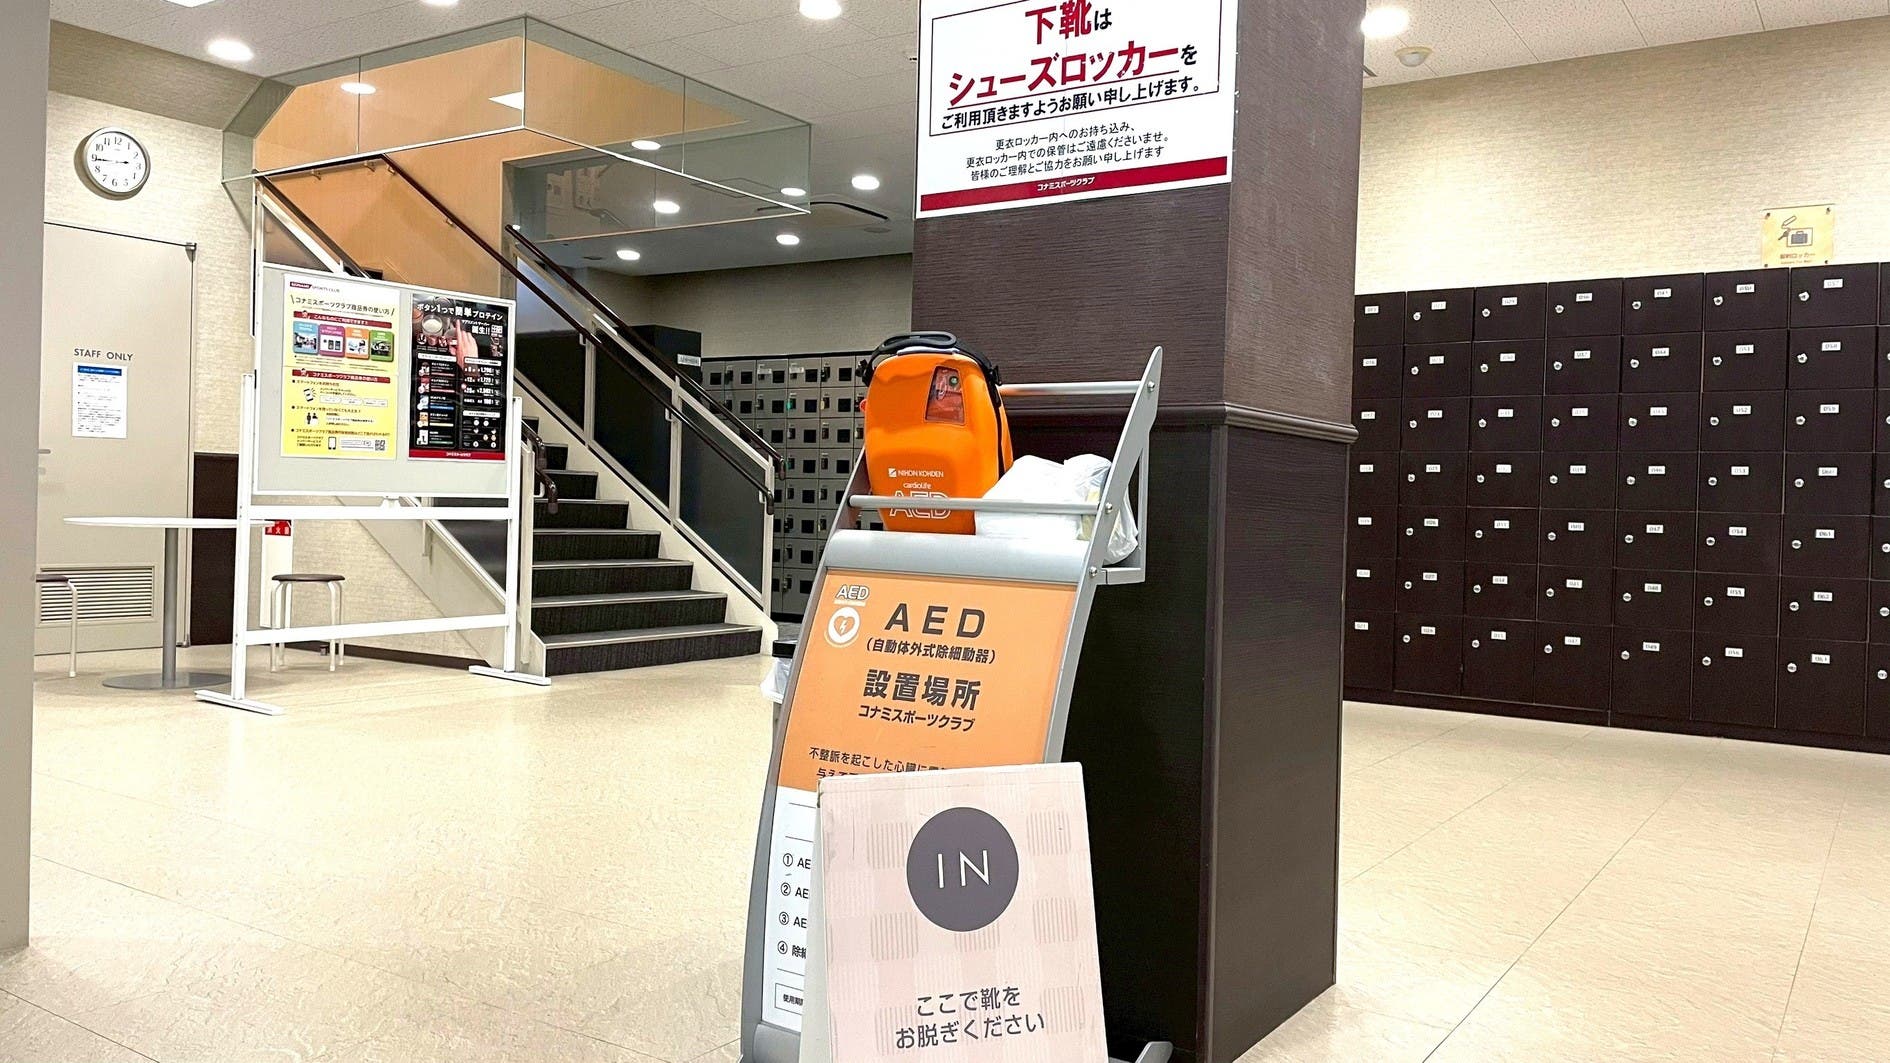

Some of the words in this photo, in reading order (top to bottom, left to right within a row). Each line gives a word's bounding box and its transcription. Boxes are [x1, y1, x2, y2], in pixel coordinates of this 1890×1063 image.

[1024, 0, 1112, 45] 下靴は
[949, 40, 1198, 107] シューズロッカーを
[941, 75, 1200, 131] ご利用頂きますようお願い申し上げます。
[115, 137, 122, 145] 12
[965, 131, 1169, 169] 更衣ロッカー内での保管はご遠慮くださいませ。
[995, 121, 1136, 151] 更衣ロッカー内へのお持ち込み、
[970, 146, 1166, 182] 皆様のご理解とご協力をお願い申し上げます
[1036, 176, 1095, 192] コナミスポーツクラブ
[74, 348, 101, 358] STAFF
[106, 351, 134, 361] ONLY
[889, 490, 951, 519] AED
[836, 584, 870, 600] AED
[885, 602, 986, 639] AED
[866, 637, 996, 665] （自動体外式除細動器）
[863, 668, 982, 711] 設置場所
[858, 704, 976, 732] コナミスポーツクラブ
[809, 747, 945, 773] 不整脈を起こした心臓に
[937, 850, 990, 889] IN
[916, 986, 1021, 1018] ここで靴を
[895, 1012, 1045, 1050] お脱ぎください
